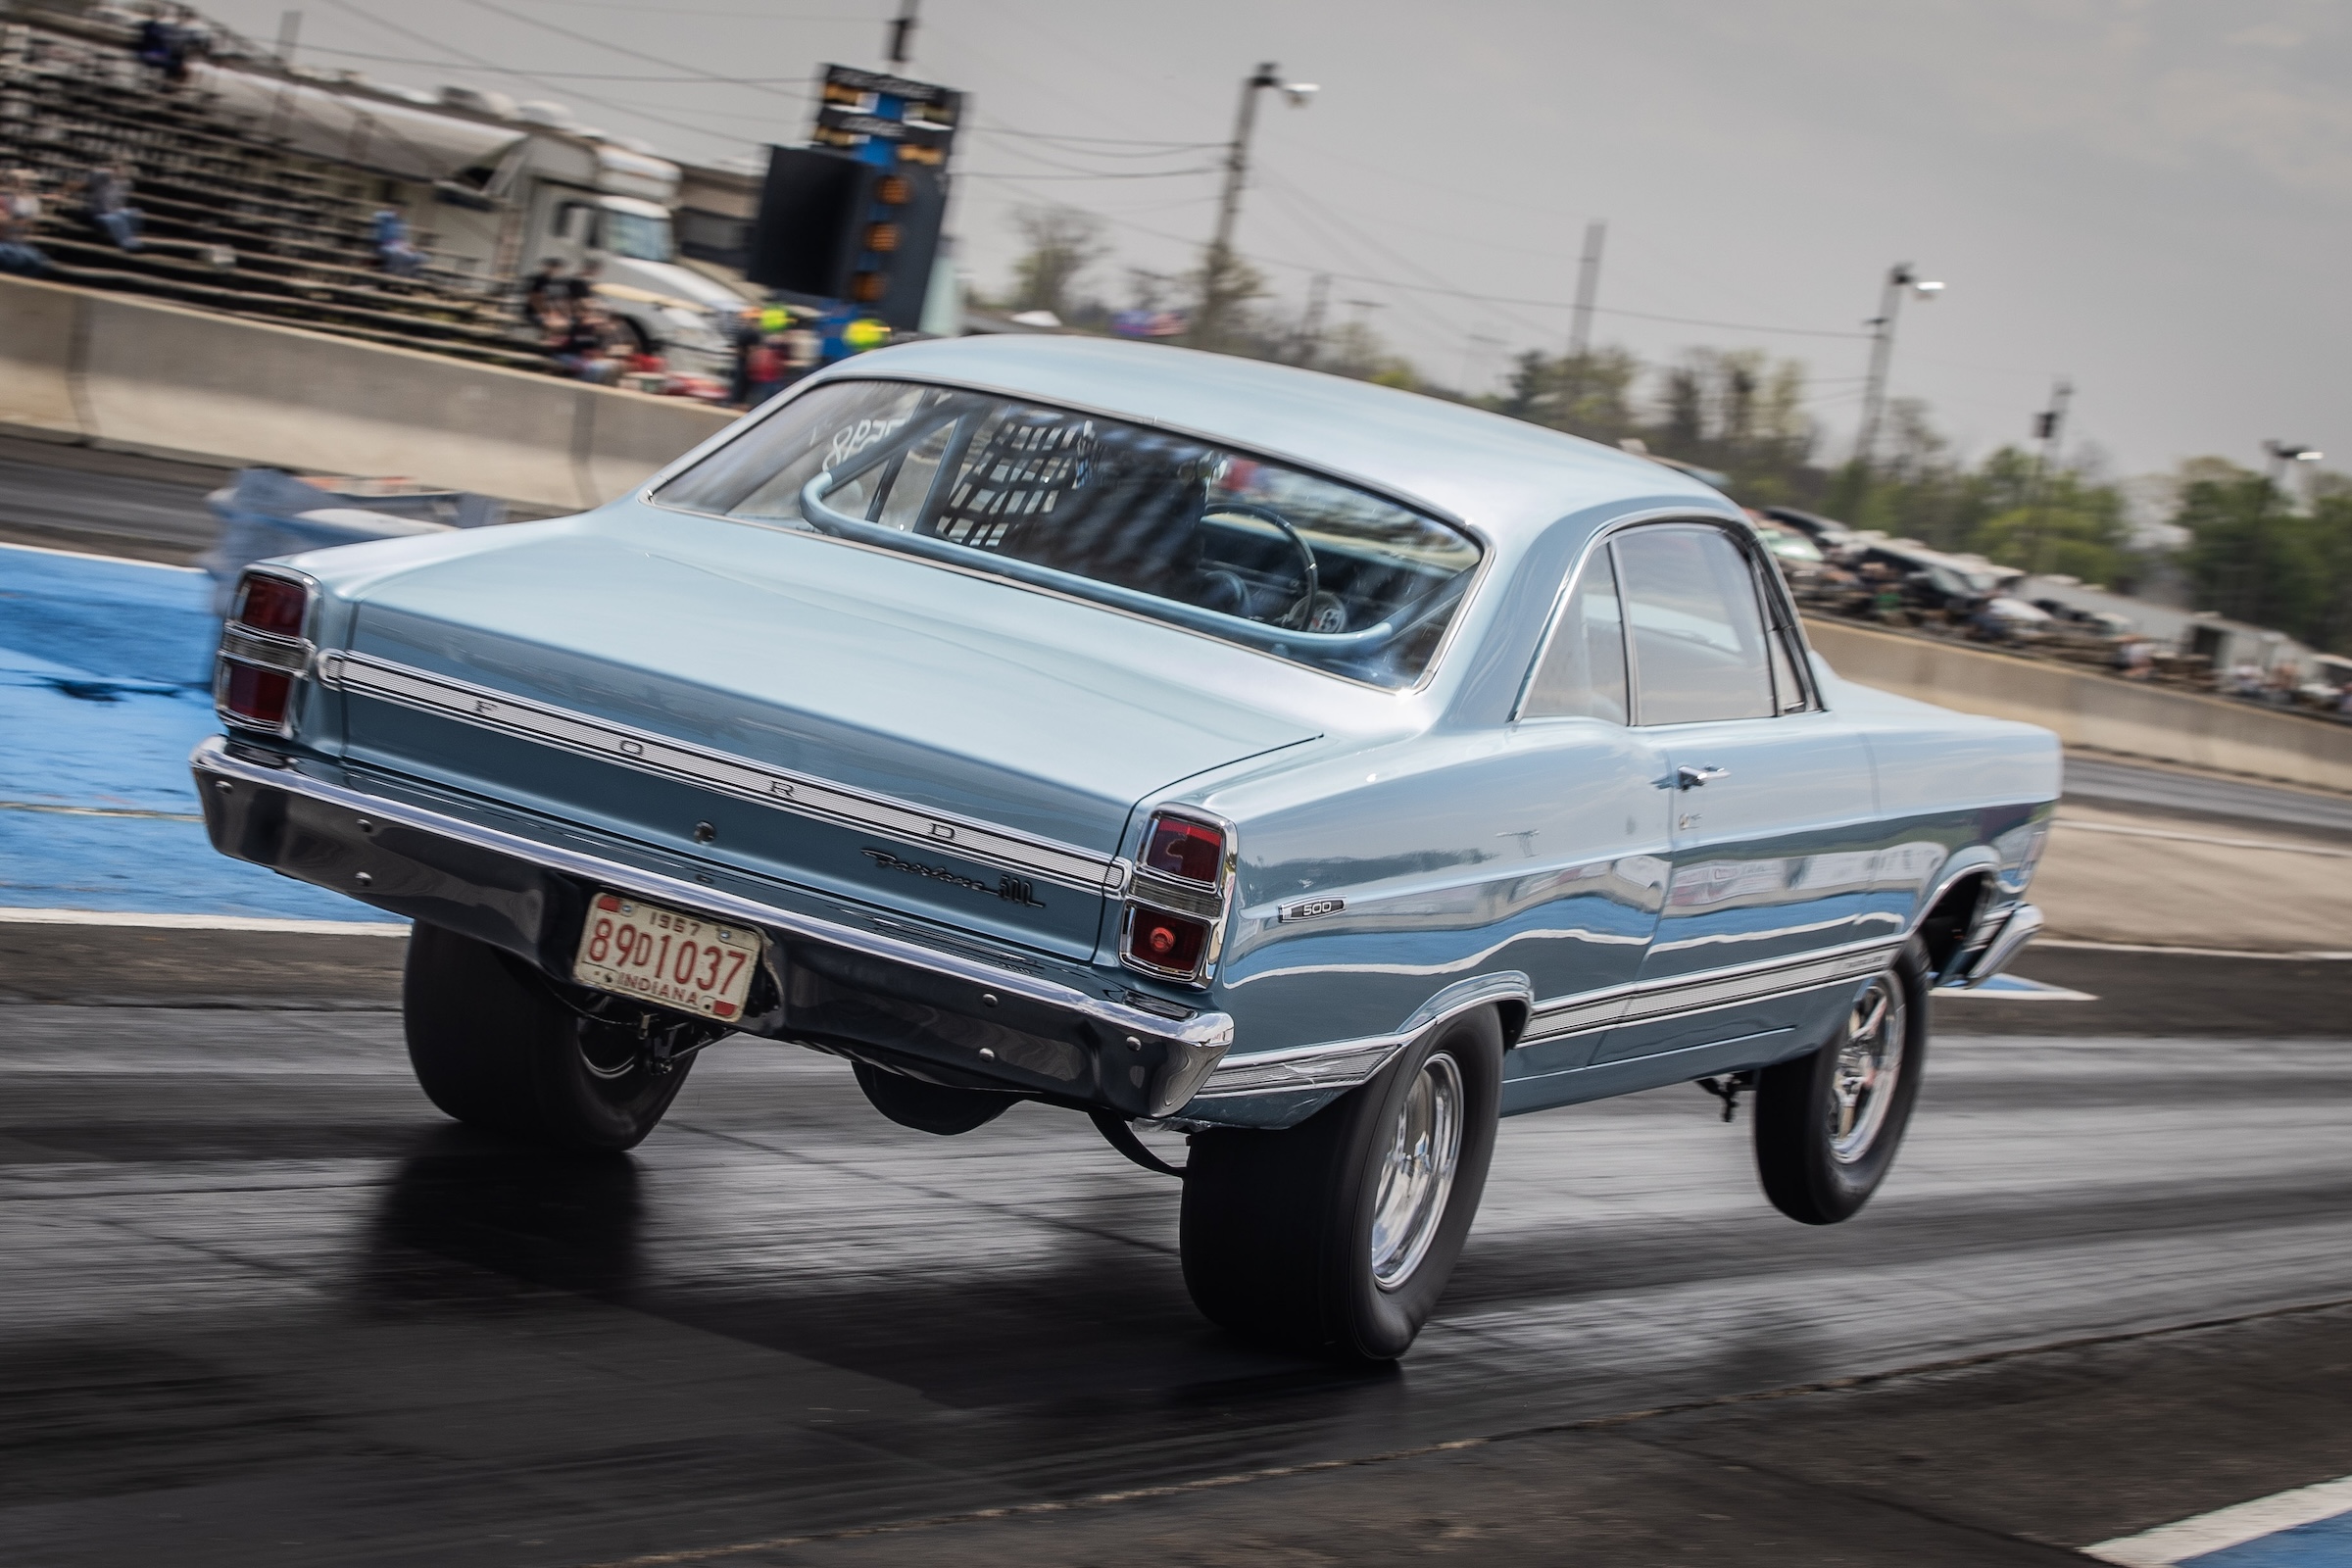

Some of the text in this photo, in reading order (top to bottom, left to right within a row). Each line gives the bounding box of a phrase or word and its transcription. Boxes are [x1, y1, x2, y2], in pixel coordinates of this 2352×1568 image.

[474, 700, 956, 841] FORD
[650, 911, 701, 936] 1967
[1303, 902, 1332, 916] 500
[589, 918, 747, 995] 89D1037
[617, 972, 698, 1005] INDIANA
